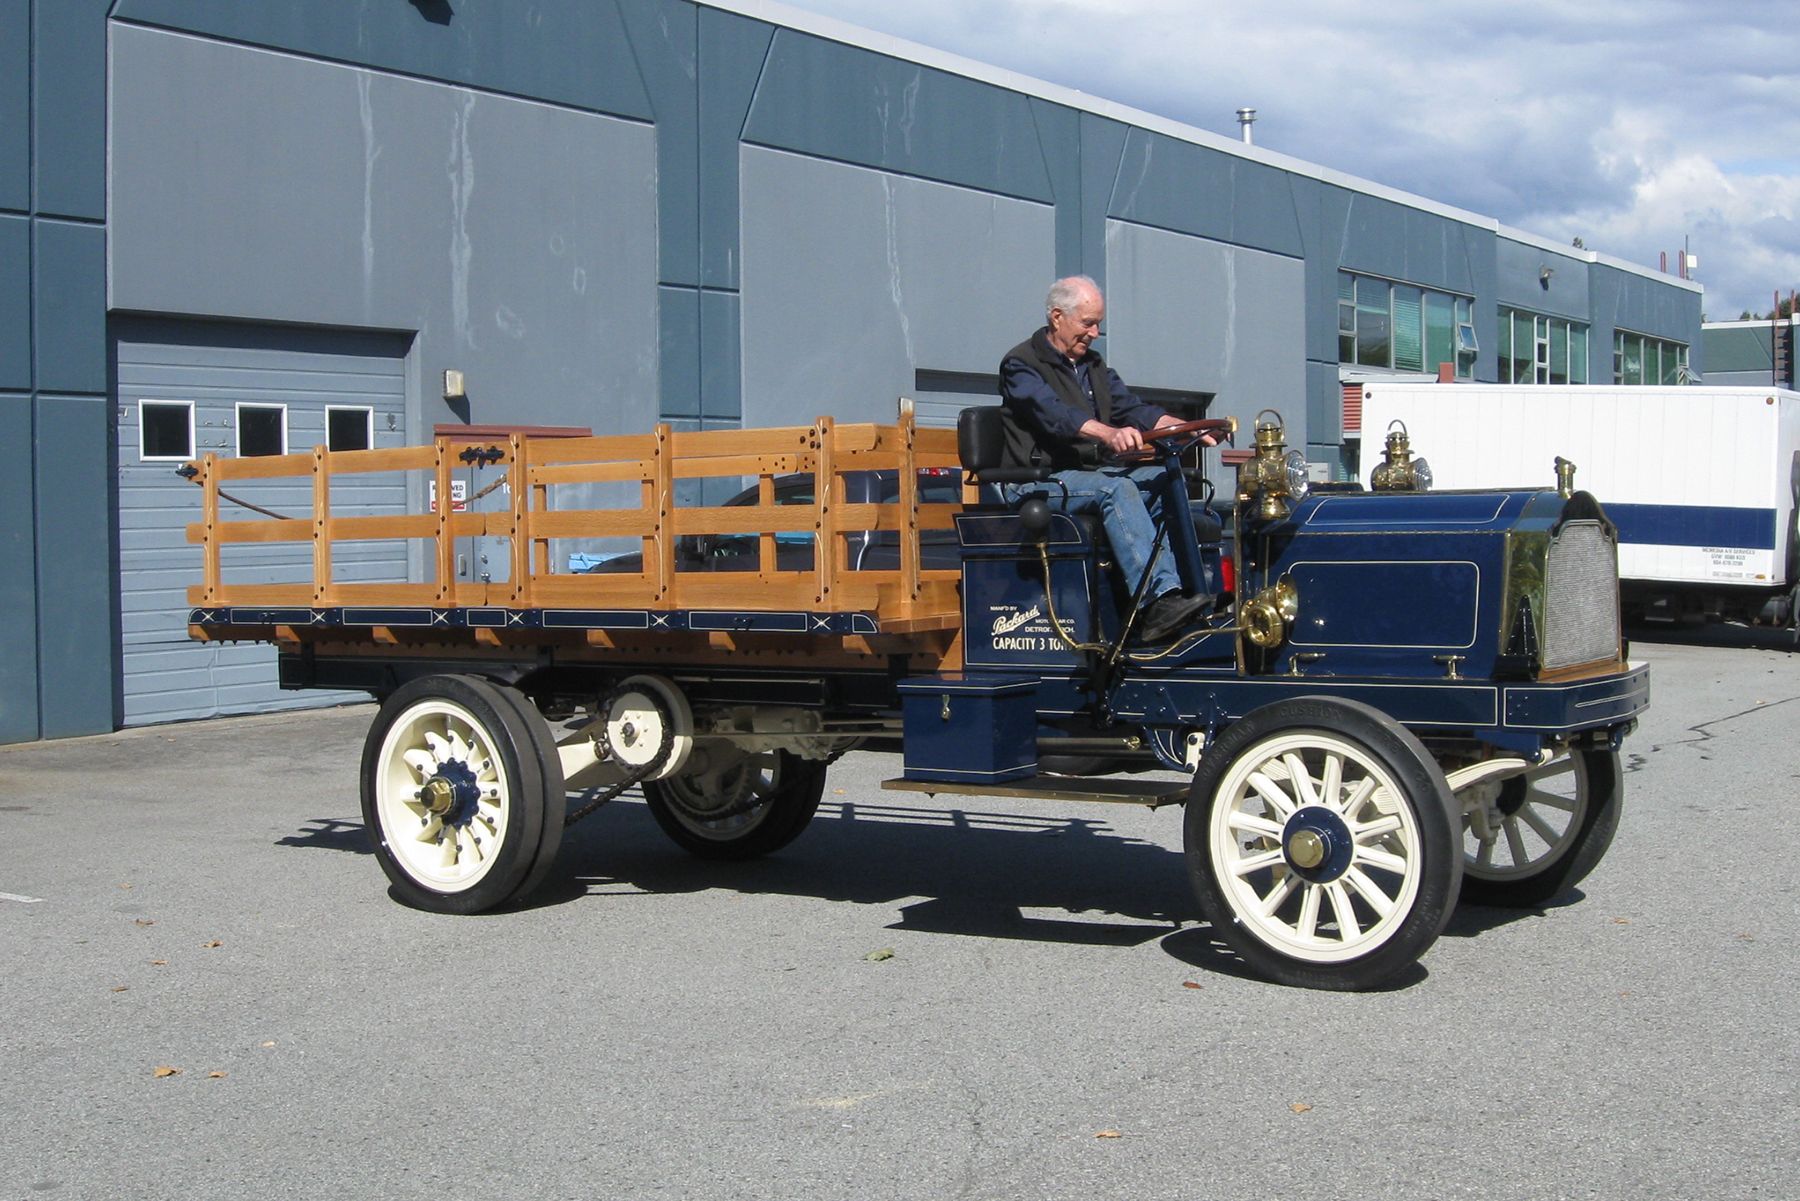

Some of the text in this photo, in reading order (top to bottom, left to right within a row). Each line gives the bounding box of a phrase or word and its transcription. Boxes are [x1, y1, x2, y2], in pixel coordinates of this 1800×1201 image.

[991, 604, 1041, 636] Packard
[993, 637, 1036, 651] CAPACITY
[1039, 637, 1046, 651] 3
